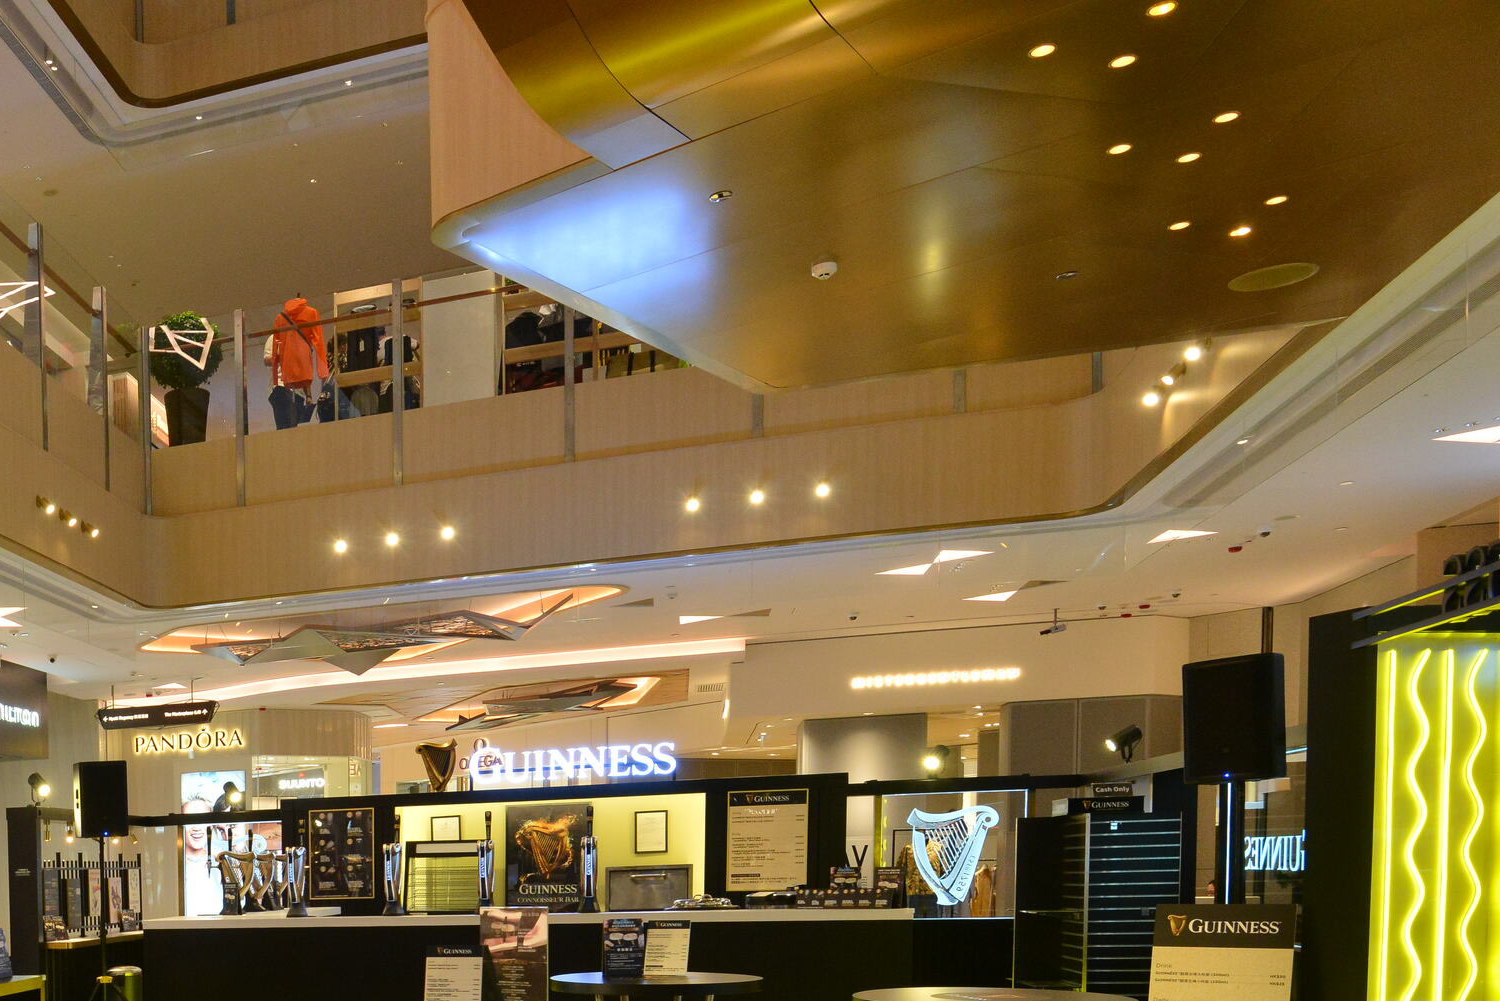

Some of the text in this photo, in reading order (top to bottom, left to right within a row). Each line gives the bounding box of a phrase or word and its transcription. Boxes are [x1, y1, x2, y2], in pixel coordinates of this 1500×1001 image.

[134, 728, 243, 753] PANDORA
[459, 754, 503, 770] OEGA
[470, 742, 677, 784] GUINNESS
[1095, 785, 1130, 794] Cash Only
[1091, 800, 1129, 808] GUINNESS
[519, 884, 577, 895] GUINNESS
[1188, 918, 1280, 934] GUINNESS
